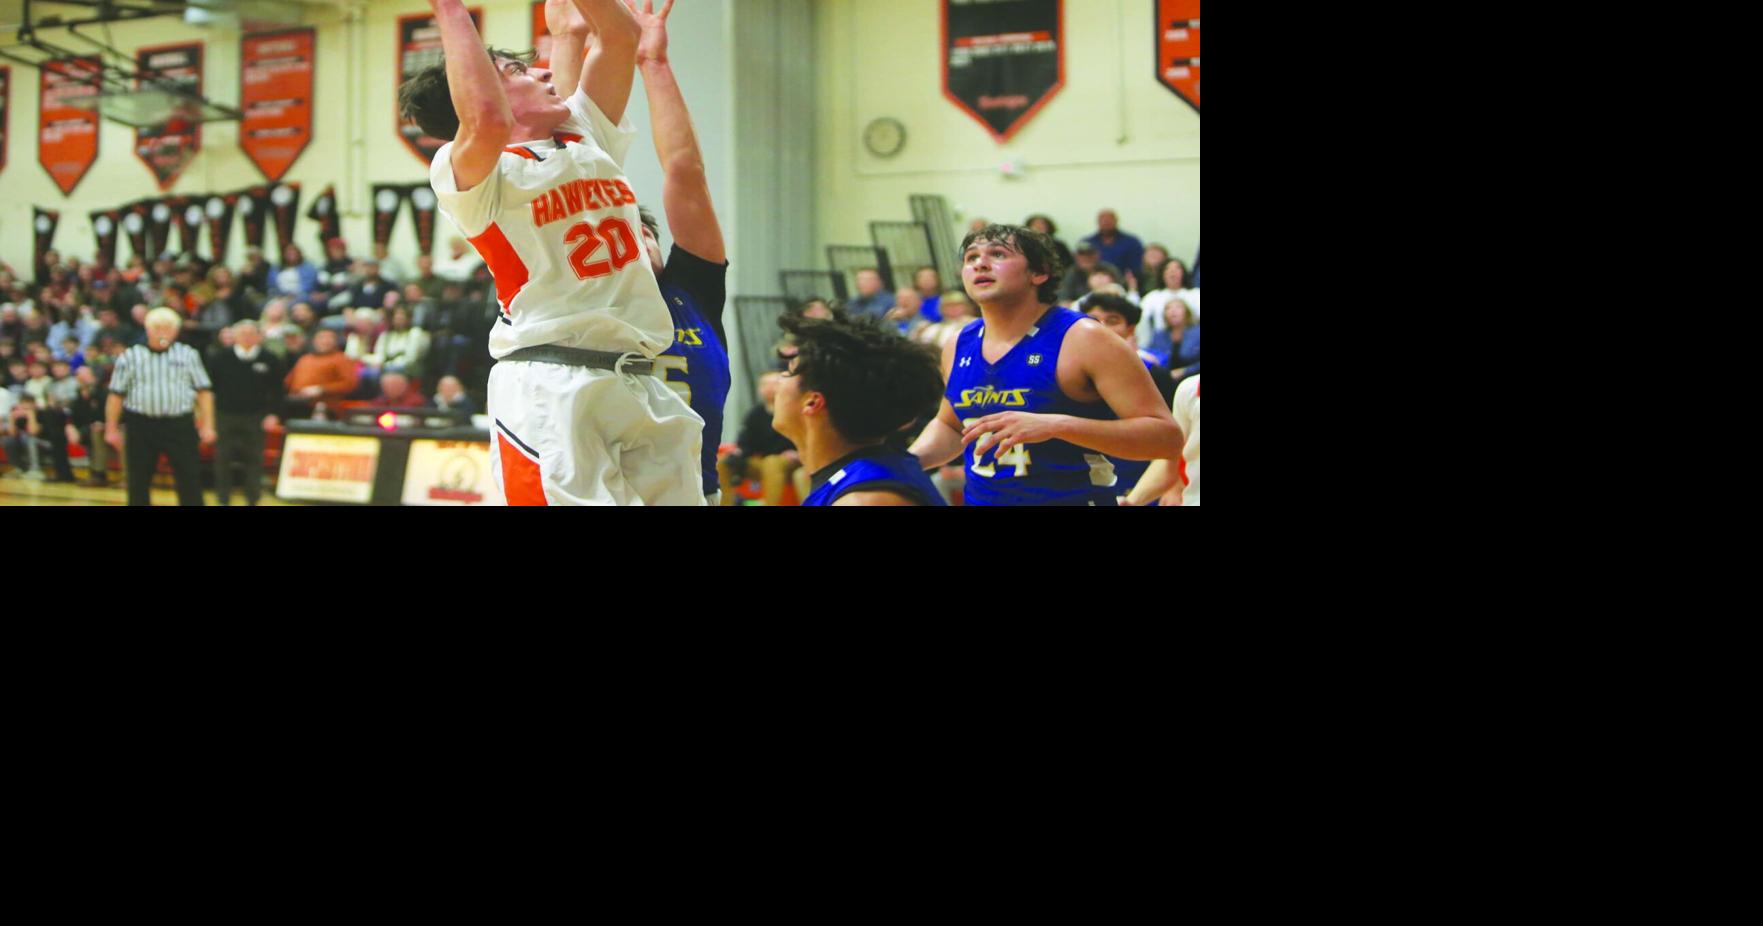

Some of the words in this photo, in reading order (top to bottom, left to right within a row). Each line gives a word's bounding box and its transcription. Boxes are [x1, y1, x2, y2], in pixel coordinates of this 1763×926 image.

[532, 179, 636, 227] HAWEYES
[564, 217, 640, 280] 20
[955, 385, 1031, 408] SAINTS
